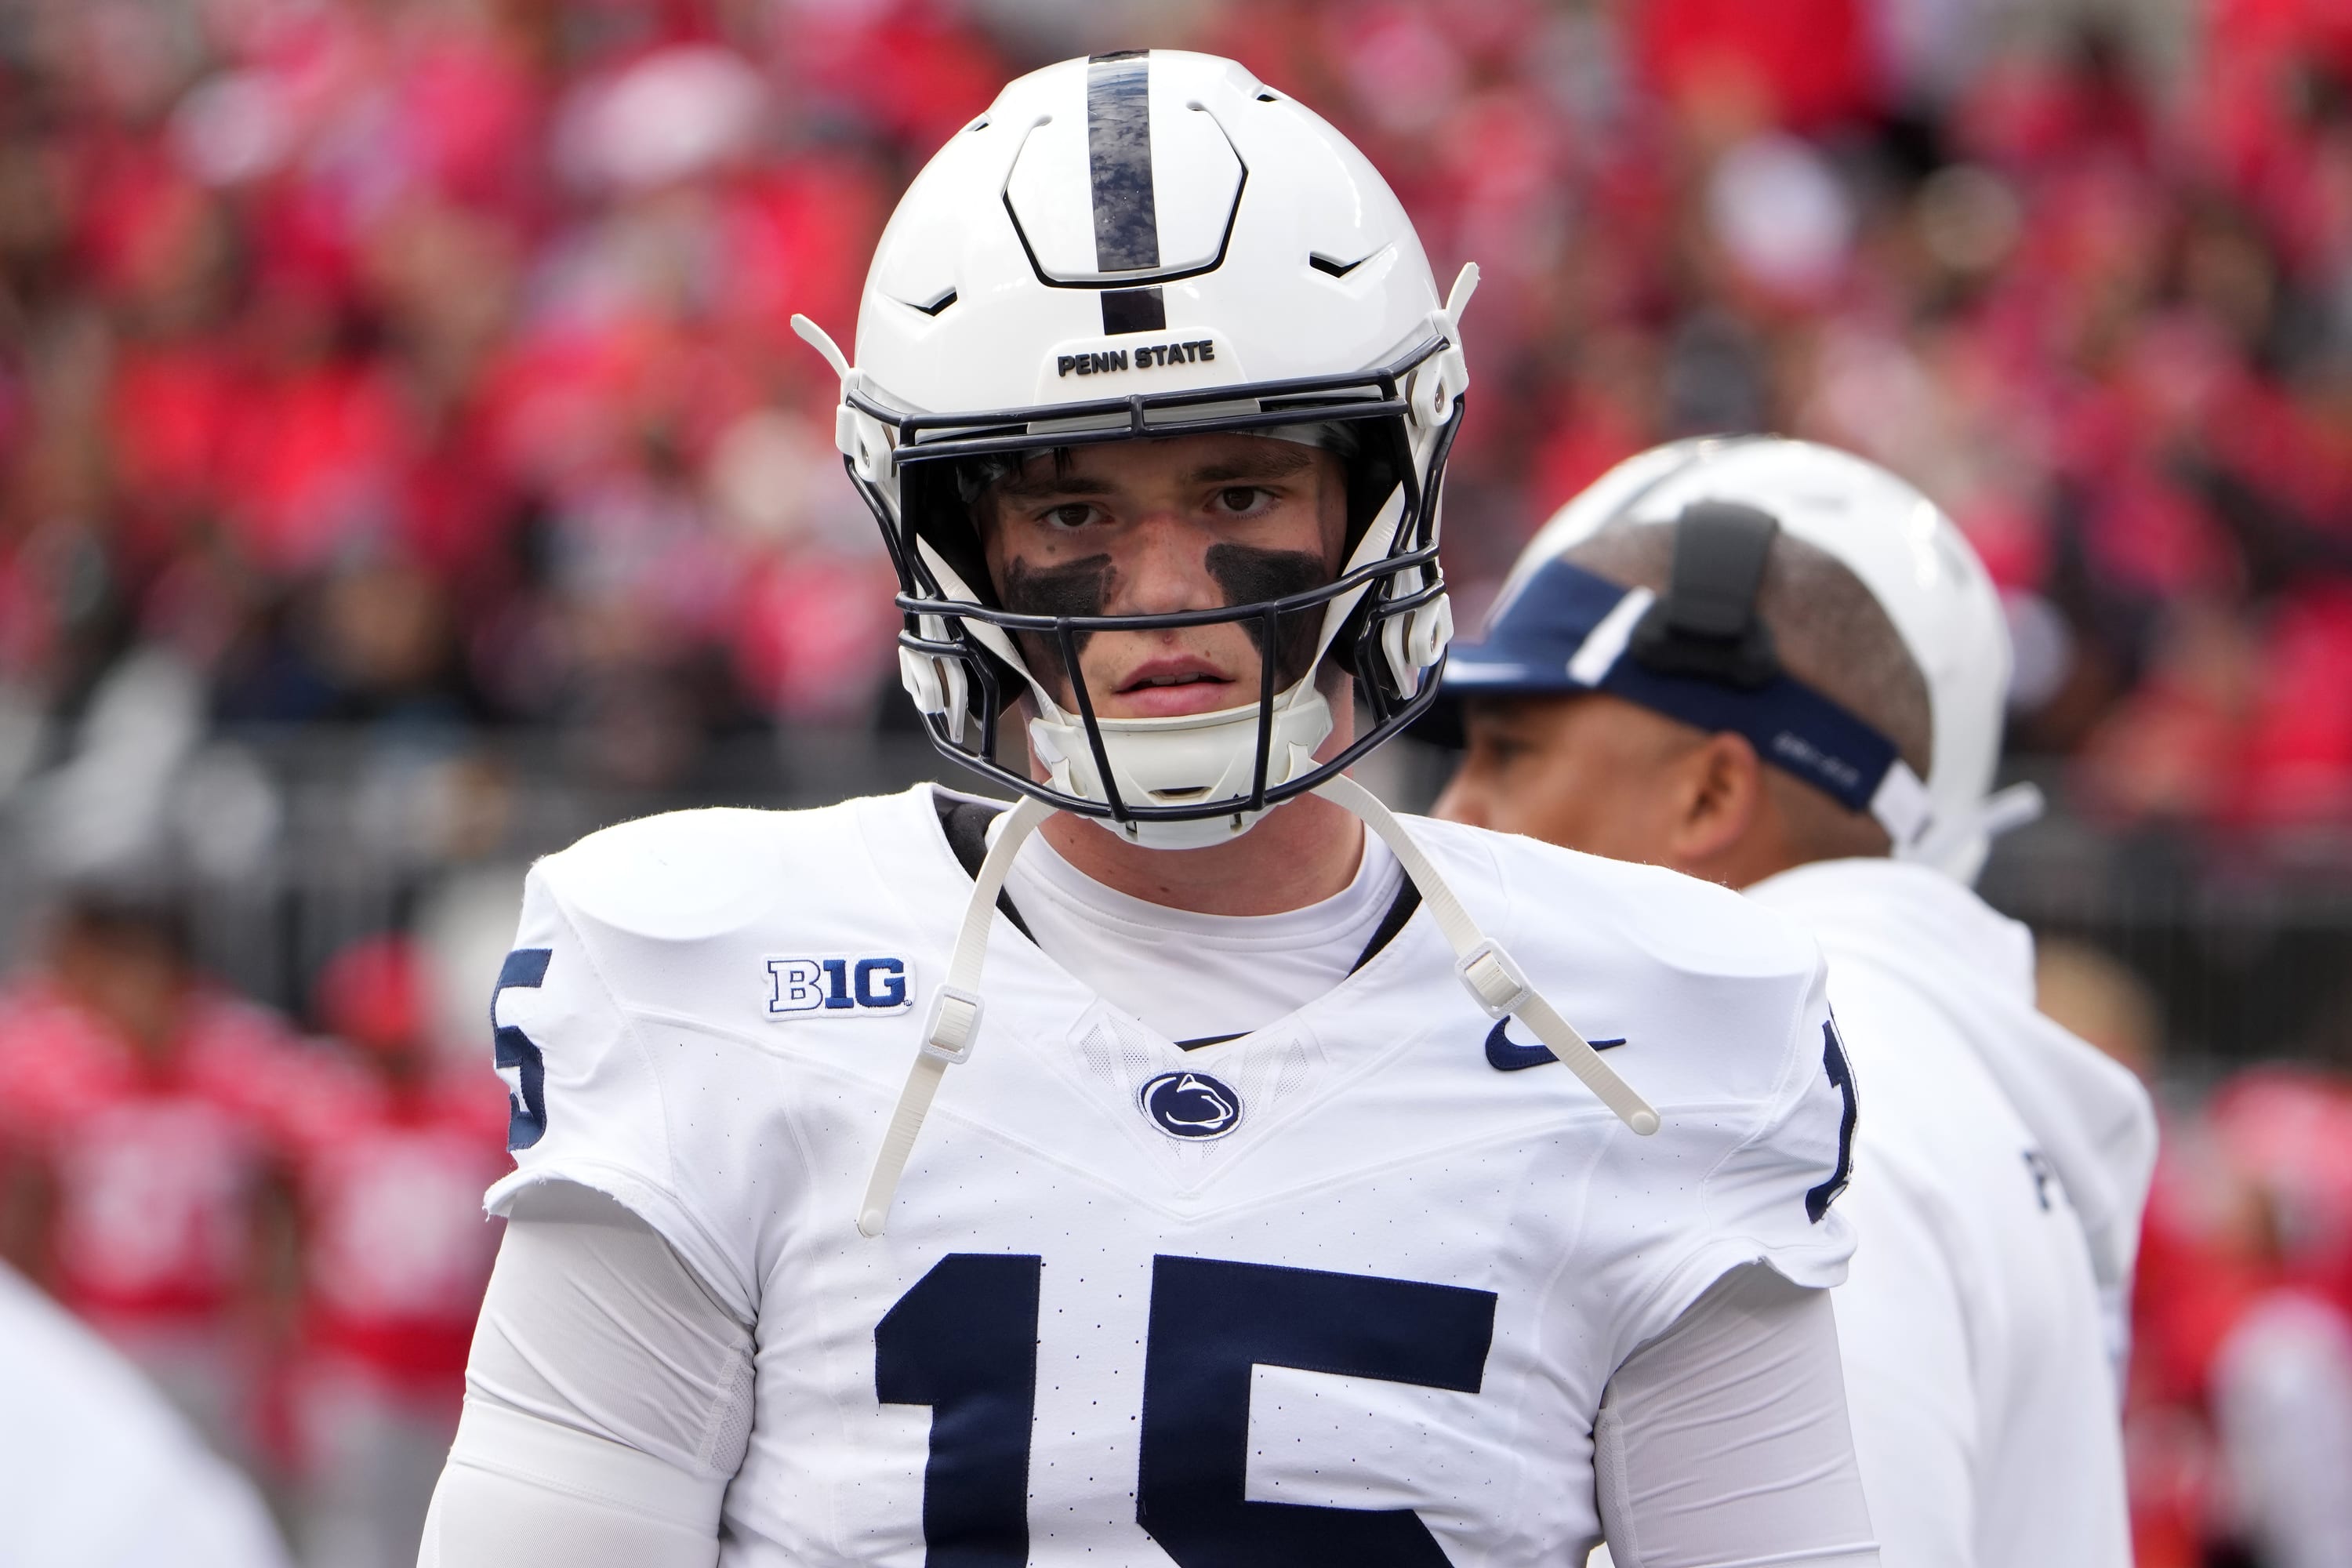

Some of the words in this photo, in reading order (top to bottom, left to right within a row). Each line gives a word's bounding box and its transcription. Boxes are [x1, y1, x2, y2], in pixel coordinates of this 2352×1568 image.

[1058, 350, 1128, 377] PENN
[1134, 339, 1214, 368] STATE
[874, 1253, 1498, 1568] 15
